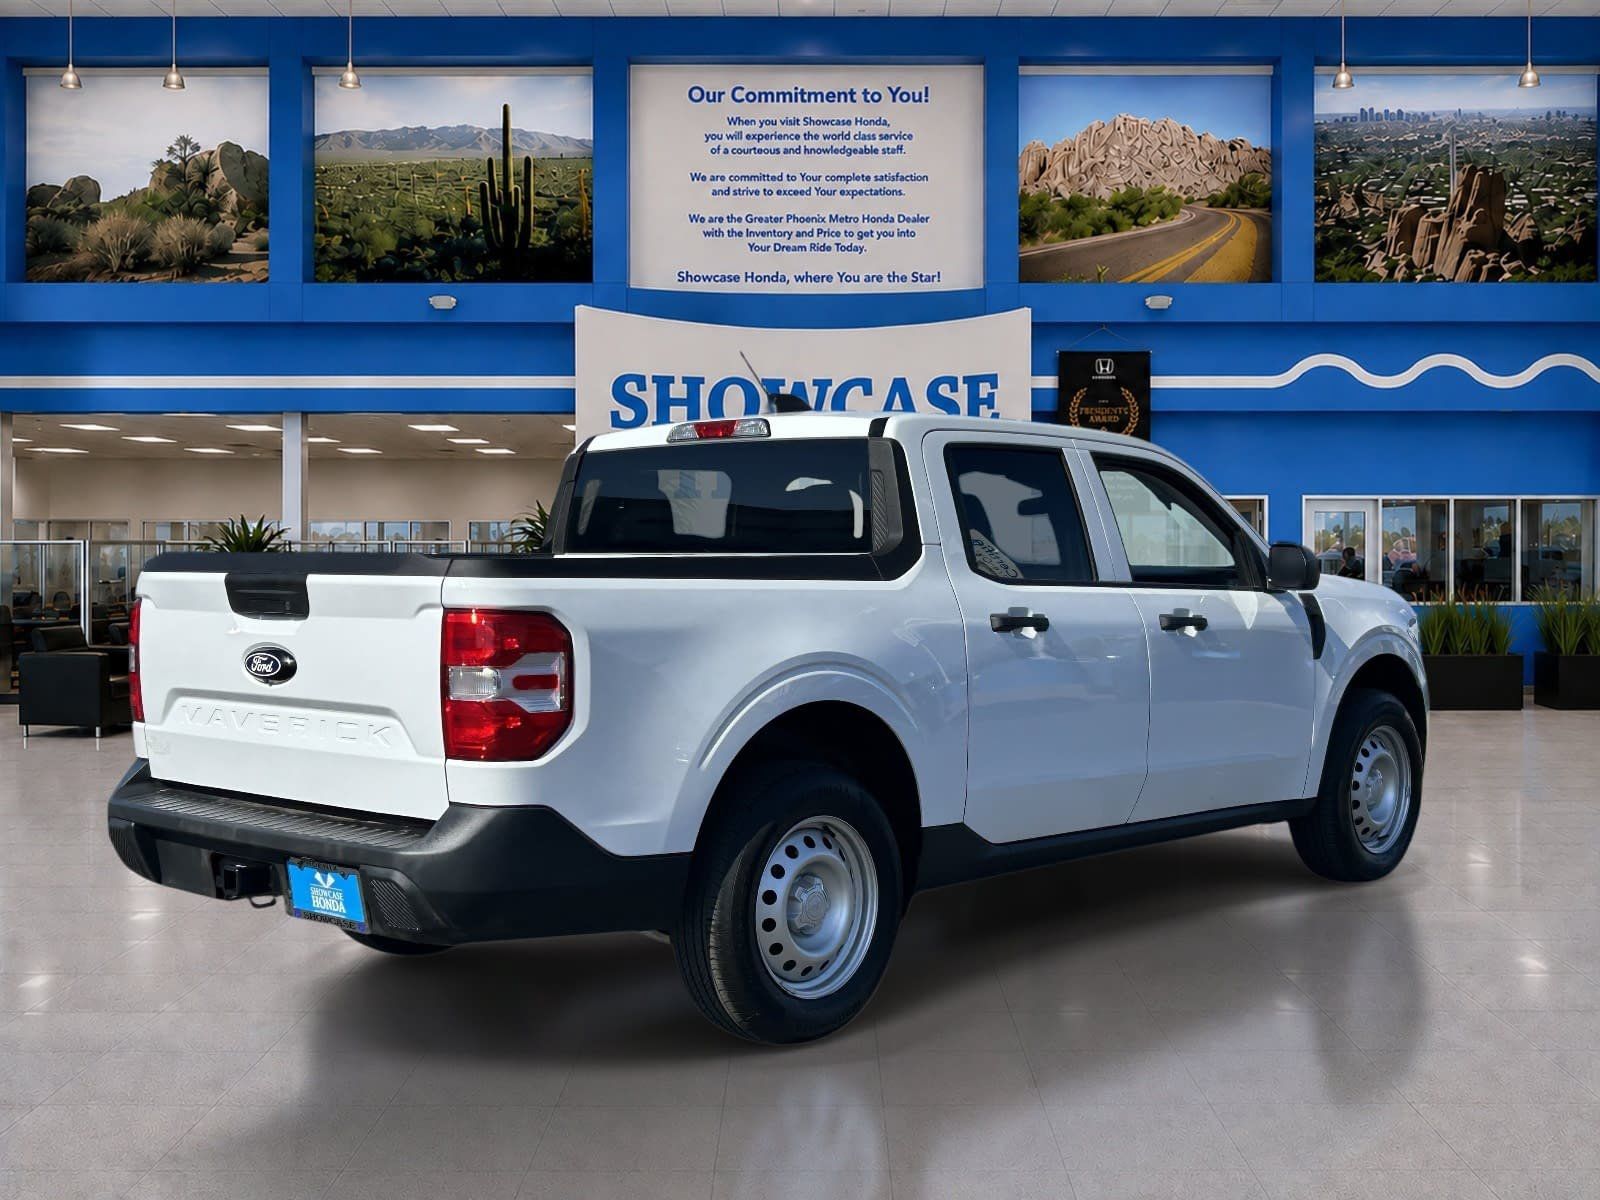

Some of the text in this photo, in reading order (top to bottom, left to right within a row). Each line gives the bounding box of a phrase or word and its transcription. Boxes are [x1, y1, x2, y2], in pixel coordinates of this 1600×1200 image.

[687, 86, 930, 103] Our Commitment to You!
[726, 116, 891, 128] When you visit Showcase Honda,
[704, 131, 914, 143] you will experience the world class service
[709, 144, 722, 154] of
[730, 147, 782, 155] courteous
[782, 145, 802, 155] and
[881, 144, 907, 155] staff.
[689, 172, 708, 182] We
[728, 172, 784, 182] committed
[785, 174, 798, 182] to
[799, 172, 823, 182] Your
[824, 172, 872, 184] complete
[873, 172, 929, 182] satisfaction
[711, 186, 906, 199] and strive to exceed Your expectations.
[688, 213, 931, 224] We are the Greater Phoenix Metro Honda Dealer
[702, 228, 917, 240] with the Inventory and Price to get you into
[747, 242, 867, 254] Your Dream Ride Today.
[676, 271, 941, 285] Showcase Honda, where You are the Star!
[251, 655, 273, 673] Ford
[179, 704, 392, 747] MAVERICK
[310, 886, 344, 901] SHOWCASE
[311, 896, 347, 913] HONDA
